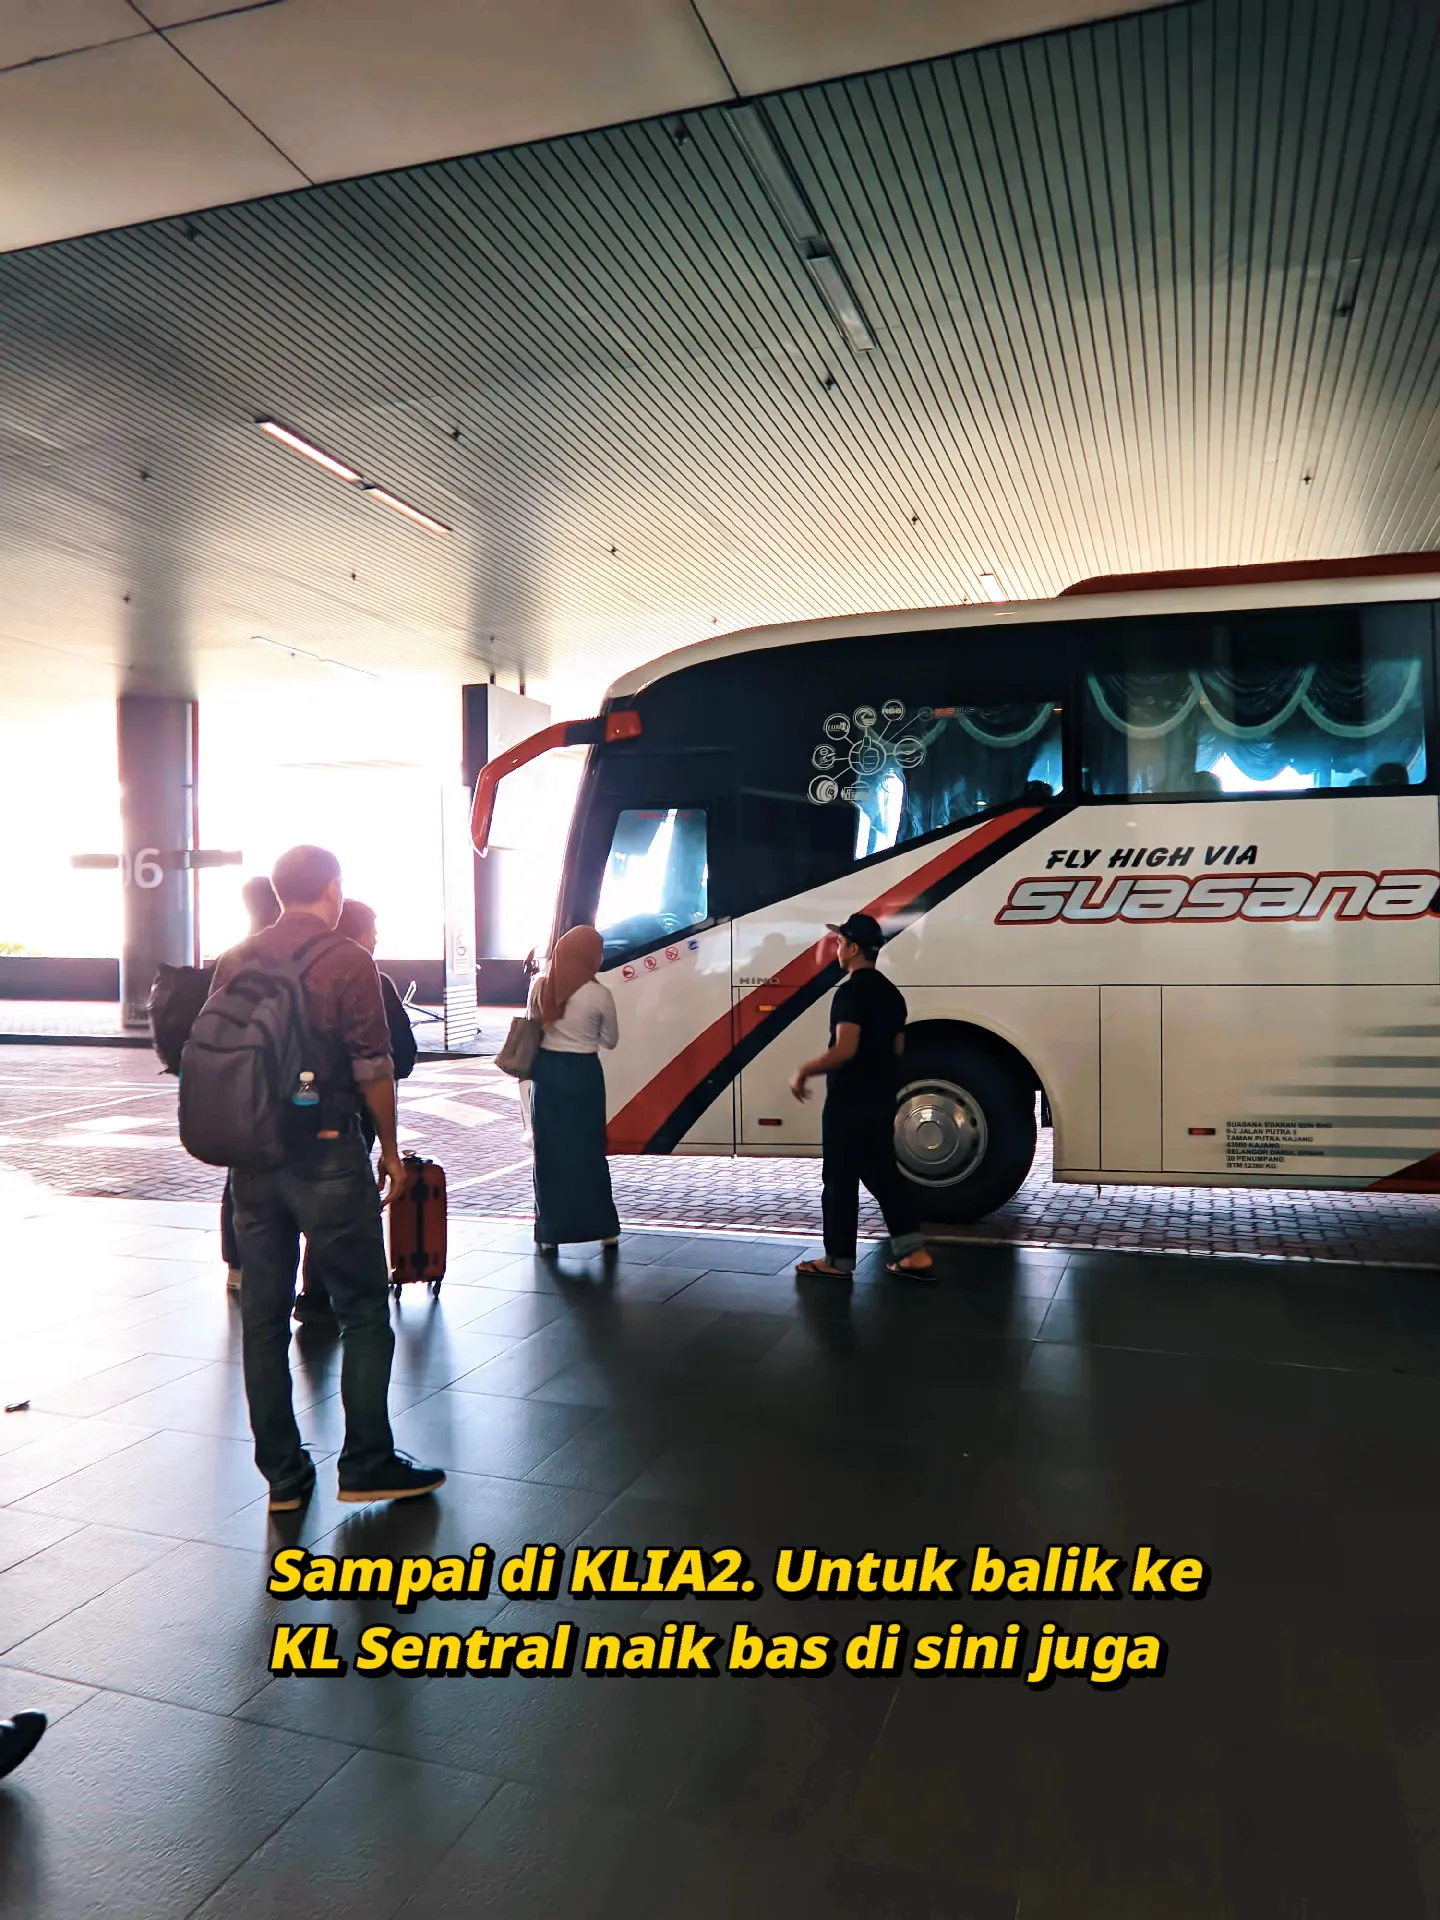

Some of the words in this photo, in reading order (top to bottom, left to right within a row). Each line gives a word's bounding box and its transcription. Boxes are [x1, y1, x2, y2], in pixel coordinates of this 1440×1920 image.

[1045, 848, 1102, 869] FLY
[1107, 846, 1195, 868] HIGH
[1203, 844, 1258, 866] VIA
[739, 977, 780, 985] HINO
[1236, 1155, 1285, 1163] PENUMPANG
